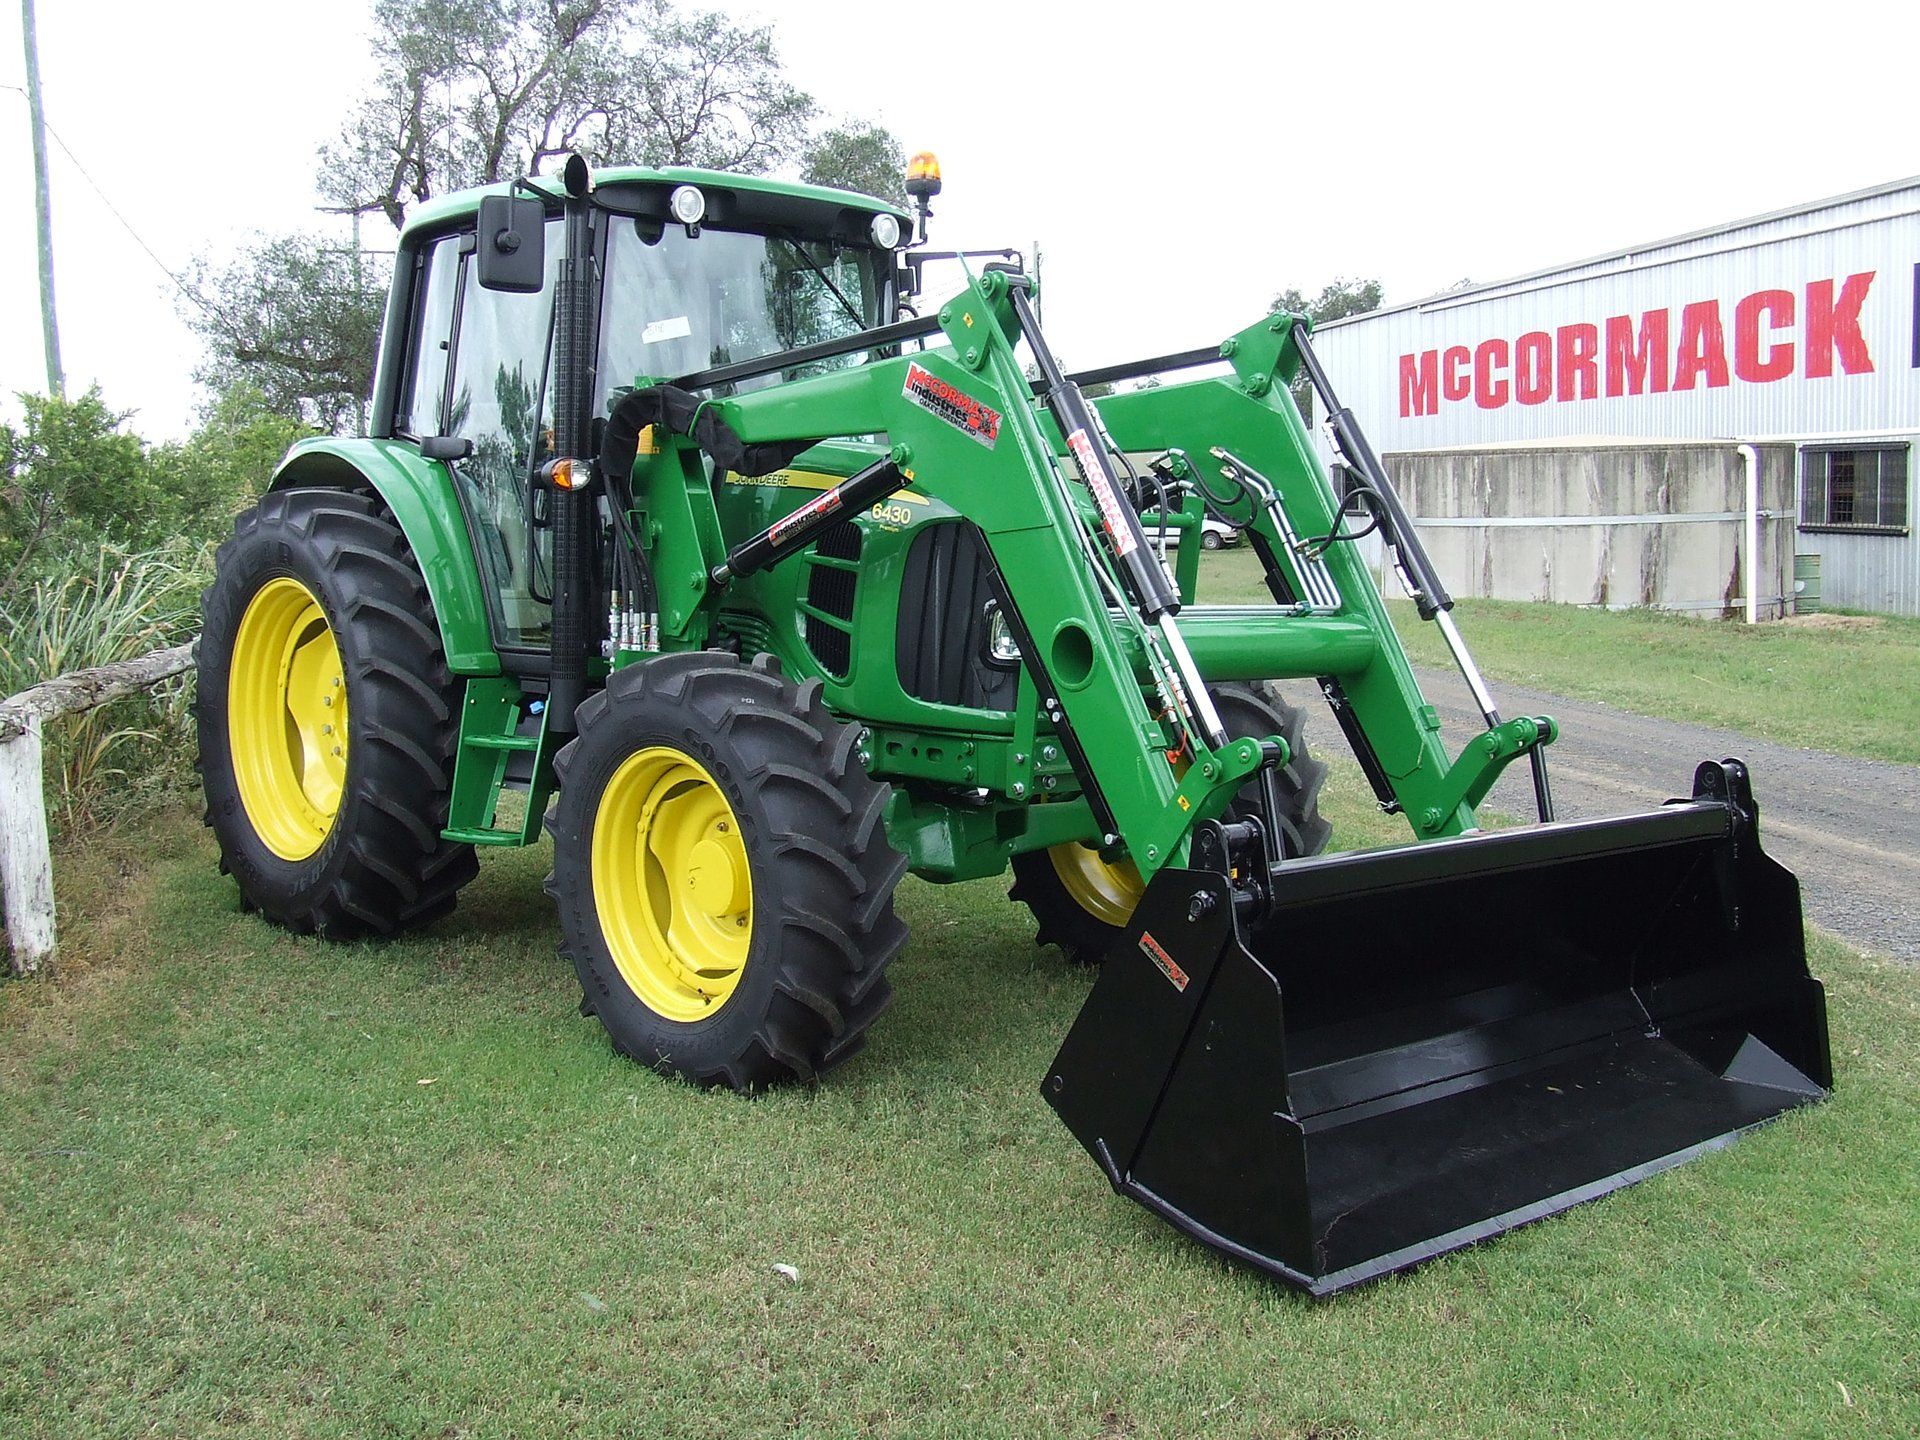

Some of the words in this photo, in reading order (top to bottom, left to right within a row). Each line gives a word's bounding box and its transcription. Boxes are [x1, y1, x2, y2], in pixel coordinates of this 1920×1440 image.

[911, 380, 969, 423] industries
[939, 408, 977, 436] QUEENSLAND
[759, 473, 790, 486] DEERE
[871, 502, 912, 525] 6430
